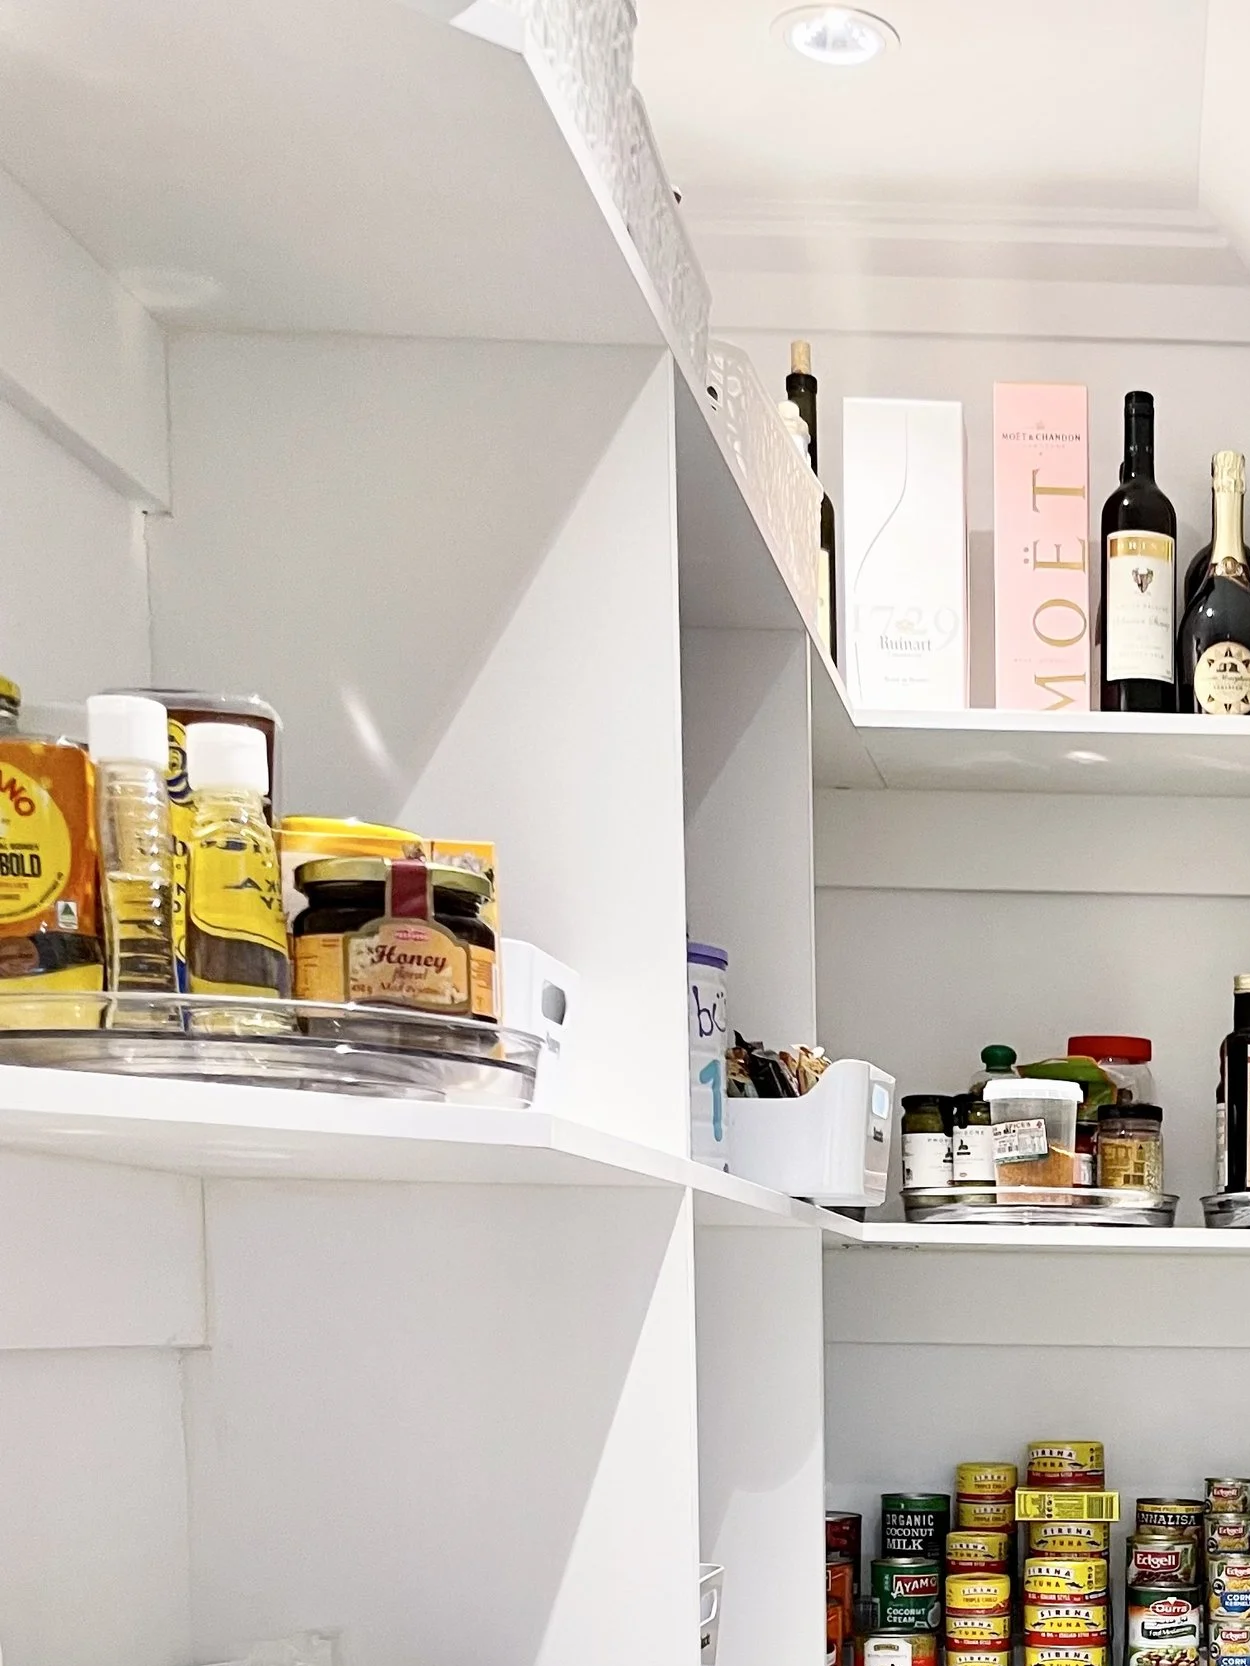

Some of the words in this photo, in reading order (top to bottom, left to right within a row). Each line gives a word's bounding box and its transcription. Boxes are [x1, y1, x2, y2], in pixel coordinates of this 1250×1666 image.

[1035, 432, 1081, 443] CHANDON
[879, 634, 932, 652] Ruinart
[0, 852, 42, 878] BOLD
[370, 943, 447, 974] Honey
[1031, 1449, 1074, 1458] SIRENA
[885, 1512, 935, 1528] ORGANIC
[1138, 1513, 1197, 1527] NNALISA
[885, 1527, 935, 1538] COCONUT
[1042, 1527, 1093, 1536] SIRENA
[886, 1538, 925, 1551] MILK
[1051, 1539, 1083, 1547] TUNA
[1136, 1553, 1176, 1568] Edgell
[1027, 1567, 1072, 1578] SIRENA
[886, 1607, 926, 1616] COCONUT
[1040, 1609, 1091, 1618] SIRENA
[886, 1615, 916, 1624] CREAM
[1221, 1631, 1247, 1642] Edgell
[1040, 1651, 1090, 1660] SIRENA
